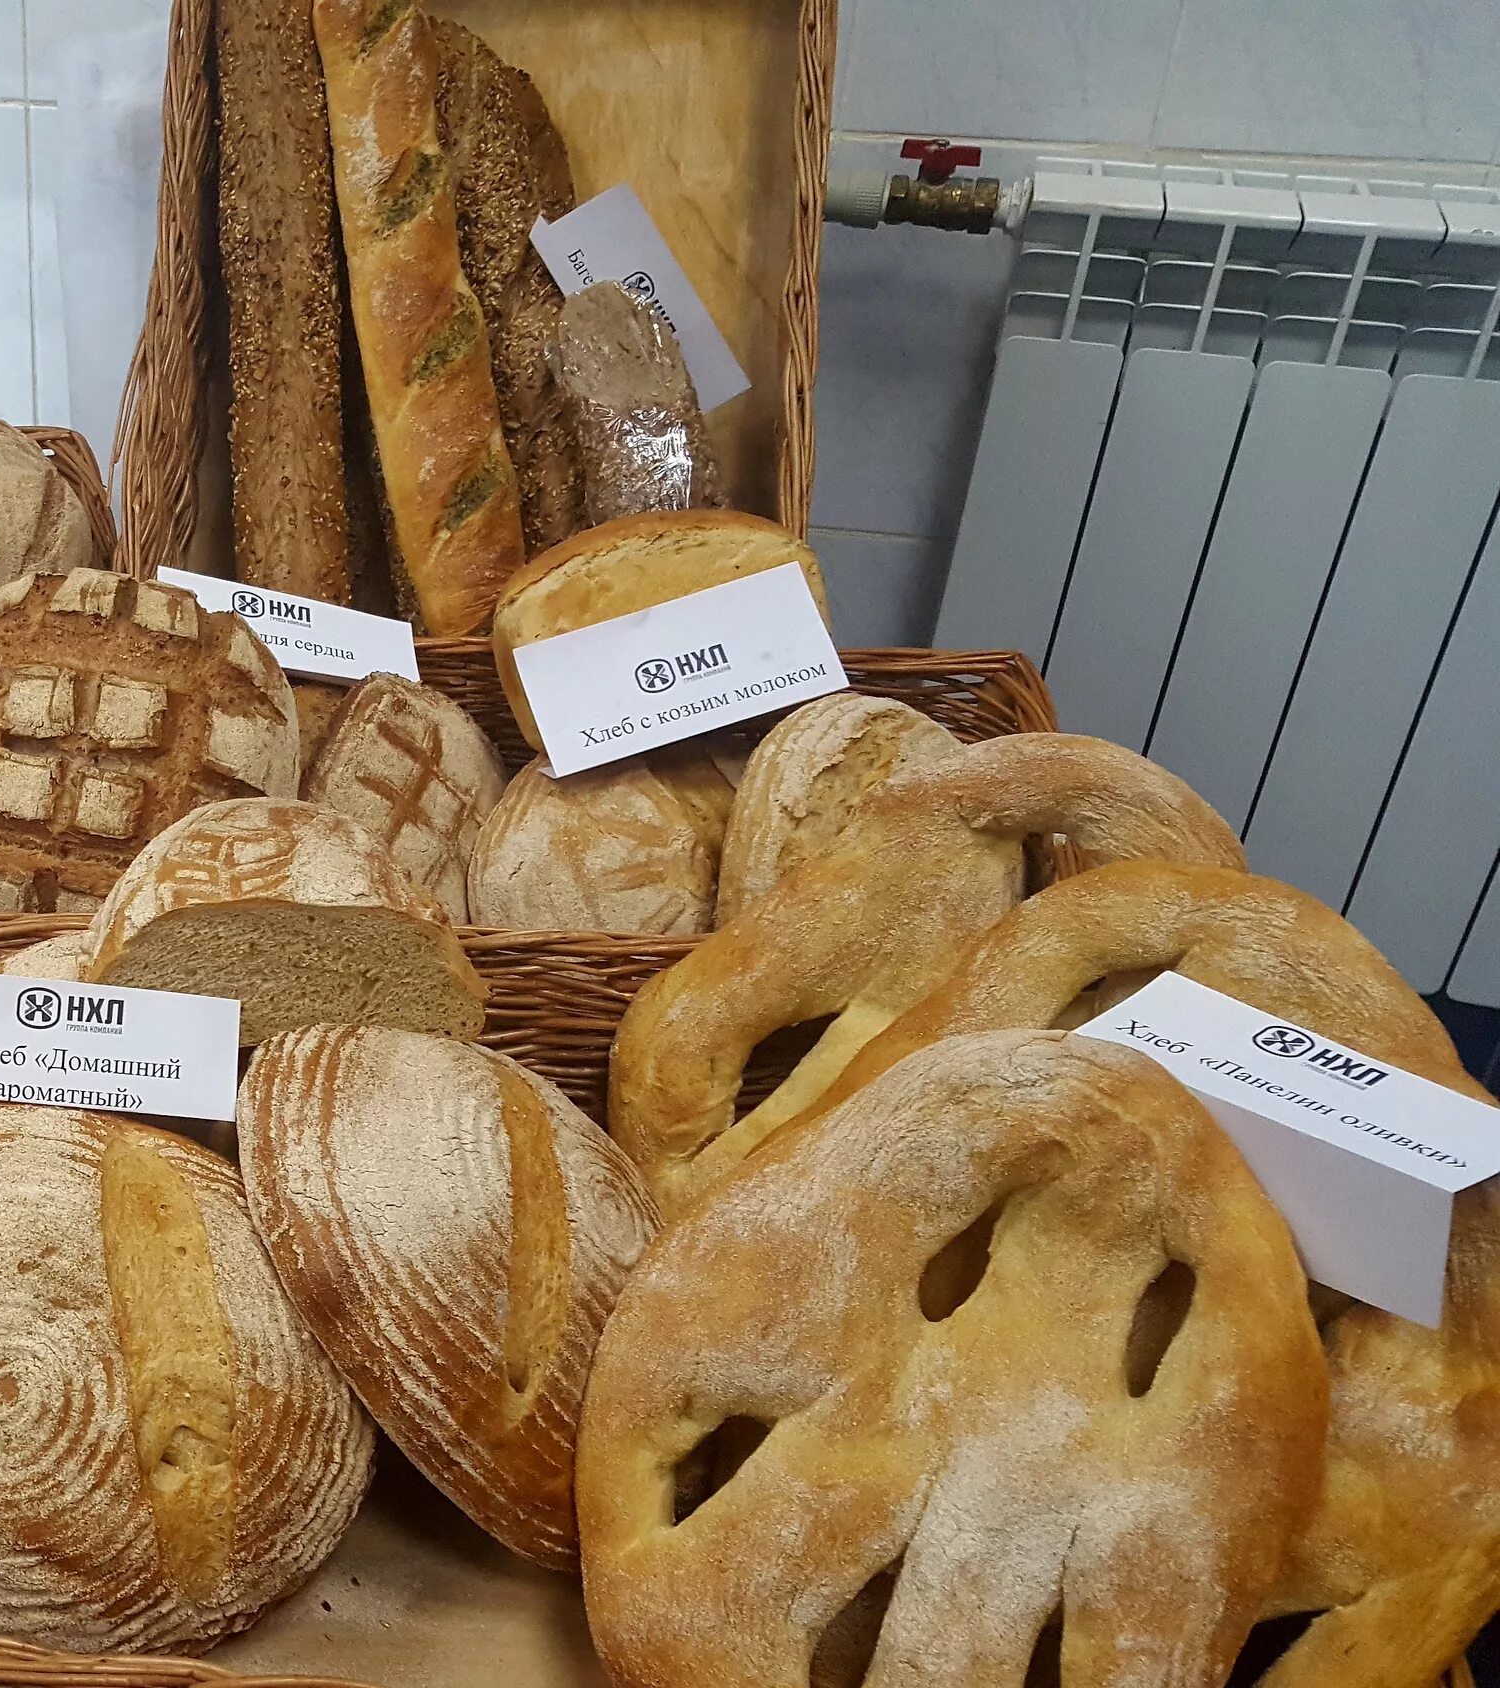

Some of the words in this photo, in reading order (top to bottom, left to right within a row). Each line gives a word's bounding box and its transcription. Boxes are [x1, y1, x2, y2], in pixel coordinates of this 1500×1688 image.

[567, 248, 596, 286] Баге
[269, 599, 311, 623] НХЛ
[294, 639, 355, 661] сердца
[674, 643, 729, 677] НХЛ
[578, 715, 635, 748] Хлеб
[640, 712, 652, 730] с
[658, 693, 731, 725] козьим
[733, 662, 828, 703] молоком
[67, 995, 125, 1025] НХЛ
[34, 1047, 182, 1080] «Домашний
[1308, 1048, 1390, 1086] НХЛ
[1115, 1018, 1194, 1055] Хлеб
[1198, 1056, 1337, 1116] «Панелин
[1339, 1114, 1468, 1170] оливки»
